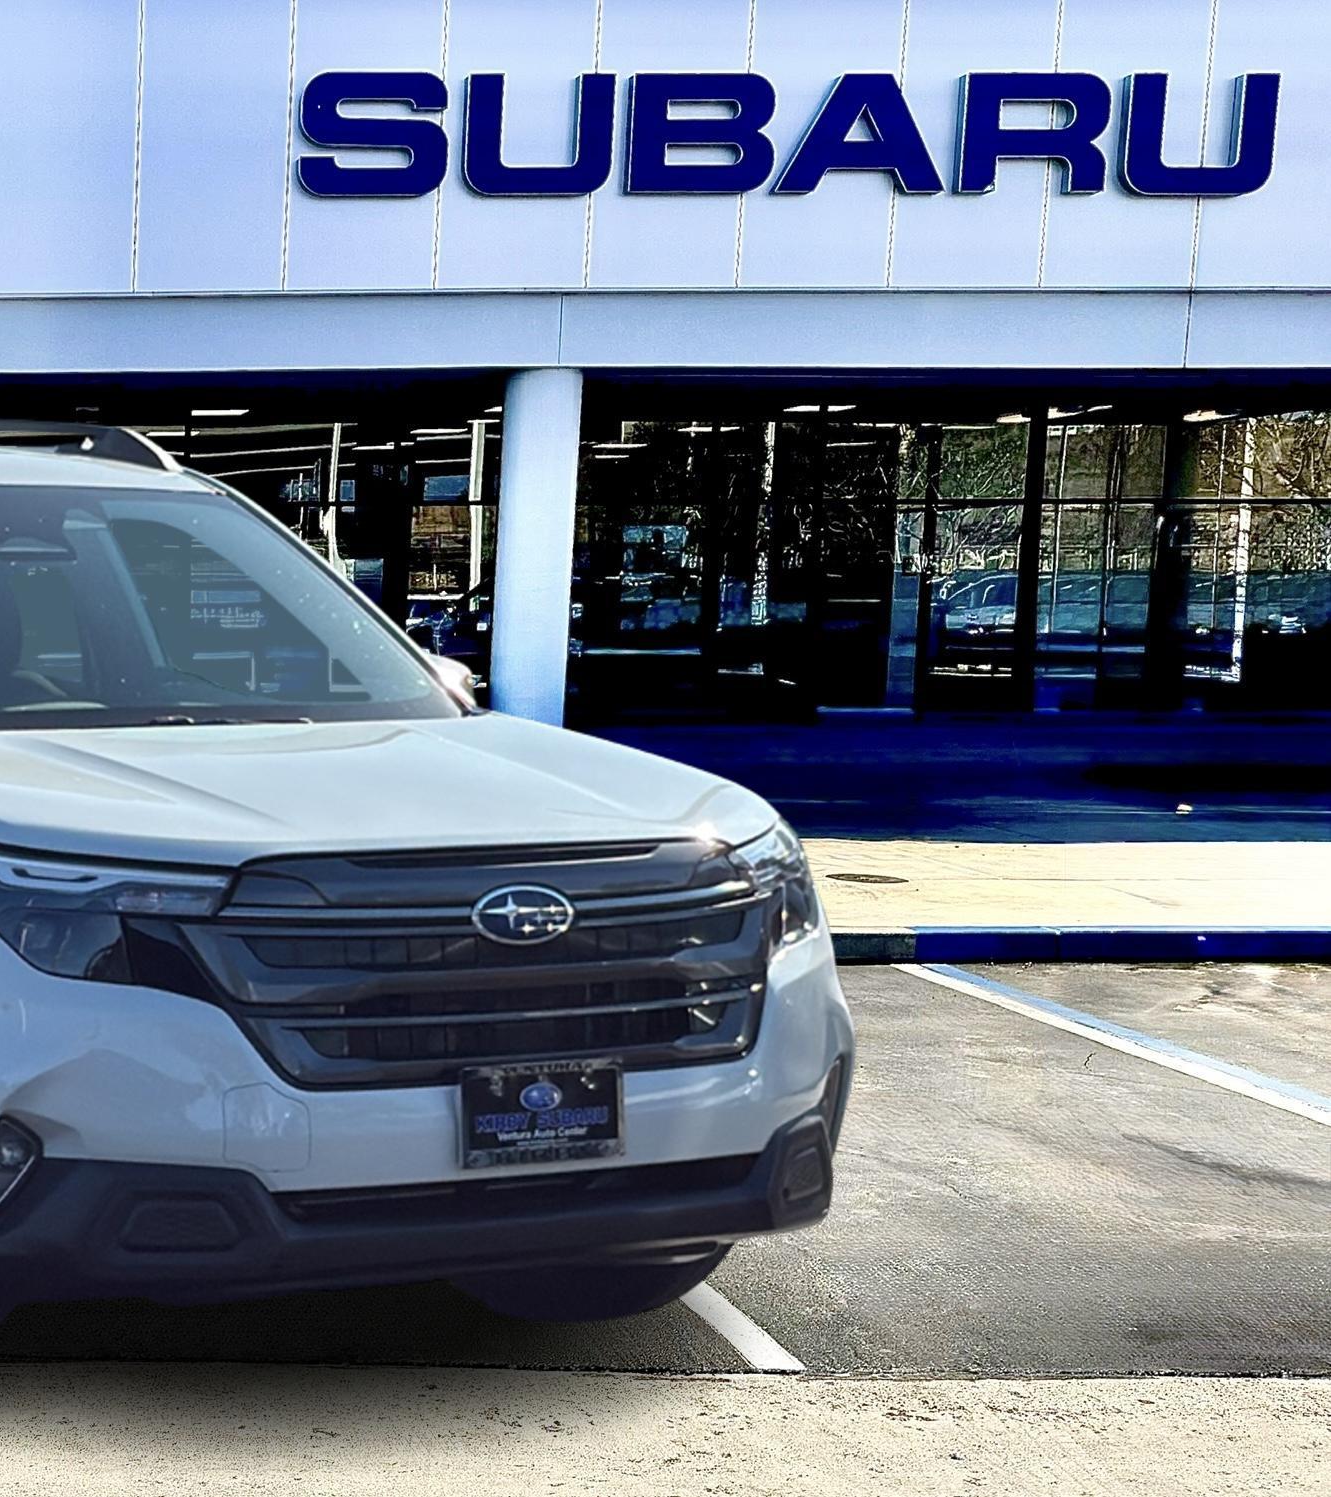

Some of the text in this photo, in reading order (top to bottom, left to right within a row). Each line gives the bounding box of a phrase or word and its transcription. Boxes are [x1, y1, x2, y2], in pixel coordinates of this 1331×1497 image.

[296, 70, 1281, 197] SUBARU
[475, 1105, 608, 1133] KIRBY SUBARU
[497, 1126, 588, 1141] Ventura Auto Center
